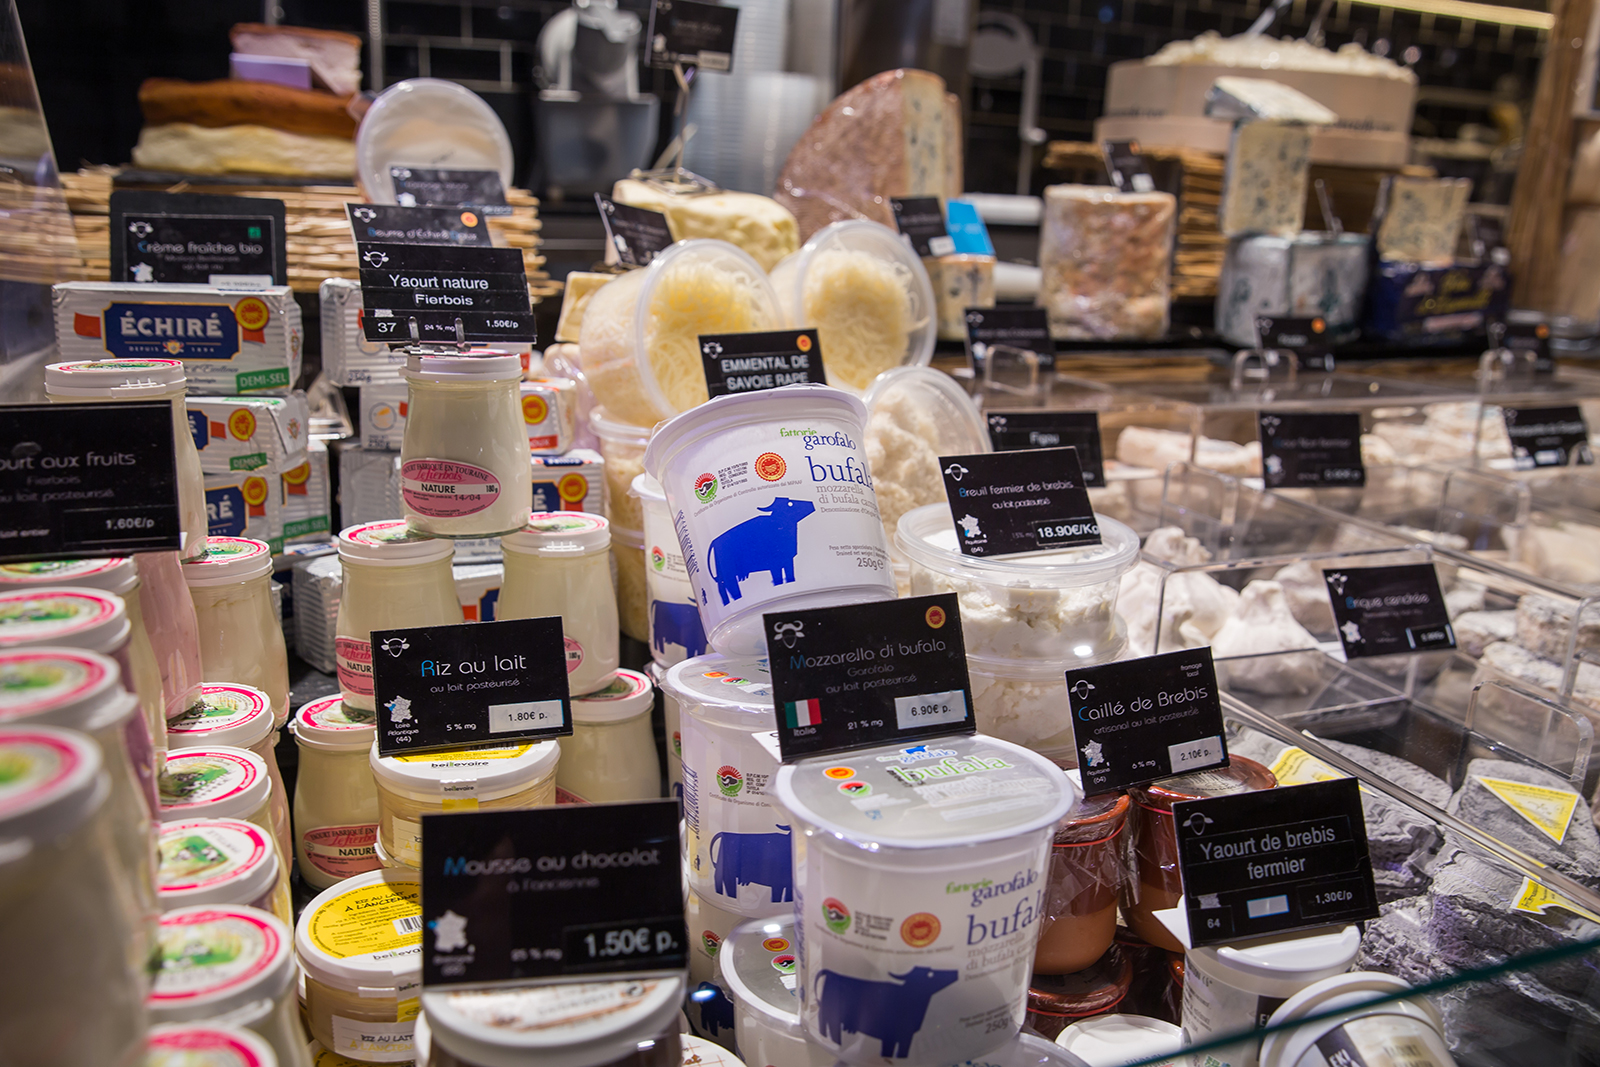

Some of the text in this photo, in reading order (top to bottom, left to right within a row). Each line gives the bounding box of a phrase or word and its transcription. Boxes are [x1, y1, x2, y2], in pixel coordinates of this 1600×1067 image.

[137, 240, 264, 255] Crème fraîche bio
[389, 274, 489, 290] Yaourt nature
[415, 293, 474, 306] Fierbois
[119, 311, 224, 338] ÉCHIRÉ
[377, 322, 396, 333] 37
[486, 319, 519, 329] 1.50€/p
[721, 354, 810, 374] EMMENTAL DE
[240, 372, 287, 388] DEMI-SEL
[726, 371, 809, 391] SAVOIE RAPE
[802, 431, 857, 451] garofalo
[41, 456, 80, 469] aux
[86, 451, 137, 467] fruits
[444, 464, 454, 472] EN
[455, 466, 489, 482] TOURAINE
[421, 483, 456, 494] NATURE
[816, 484, 865, 495] mozzarella
[958, 479, 1074, 498] Breuil fermier de brebis
[818, 493, 860, 504] di bufala
[105, 517, 155, 530] 1.60€/p
[1037, 522, 1100, 539] 18.90€/Kg
[790, 638, 947, 670] Mozzarella di bufala
[346, 661, 372, 673] NATUR
[421, 654, 527, 677] Riz au lait
[847, 663, 895, 678] Garofalo
[430, 678, 520, 693] au lait pasteurisé
[825, 673, 918, 694] au lait pasteurisé
[910, 704, 952, 717] 6.90€ p.
[1078, 685, 1209, 722] Caillé de Brebis
[508, 710, 548, 722] 1.80€ p.
[446, 724, 453, 732] 5
[464, 722, 477, 731] mg
[793, 727, 817, 737] Italie
[847, 719, 884, 730] 21 % mg
[1093, 721, 1130, 735] artisanal
[1131, 719, 1143, 728] au
[395, 735, 412, 744] (44)
[1180, 749, 1203, 761] 2.10€
[431, 761, 489, 769] beillevaire
[891, 755, 1012, 783] bufala
[364, 827, 374, 835] EN
[1200, 825, 1336, 861] Yaourt de brebis
[338, 847, 377, 857] NATURE
[443, 847, 661, 877] Mousse au chocolat
[1247, 855, 1306, 880] fermier
[970, 868, 1039, 908] garofalo
[1206, 916, 1221, 930] 64
[583, 927, 679, 958] 1.50€ p.
[372, 945, 423, 961] beilleva
[377, 1034, 391, 1042] AU
[392, 1034, 414, 1042] LAIT
[360, 1043, 414, 1052] L'ANCIEN
